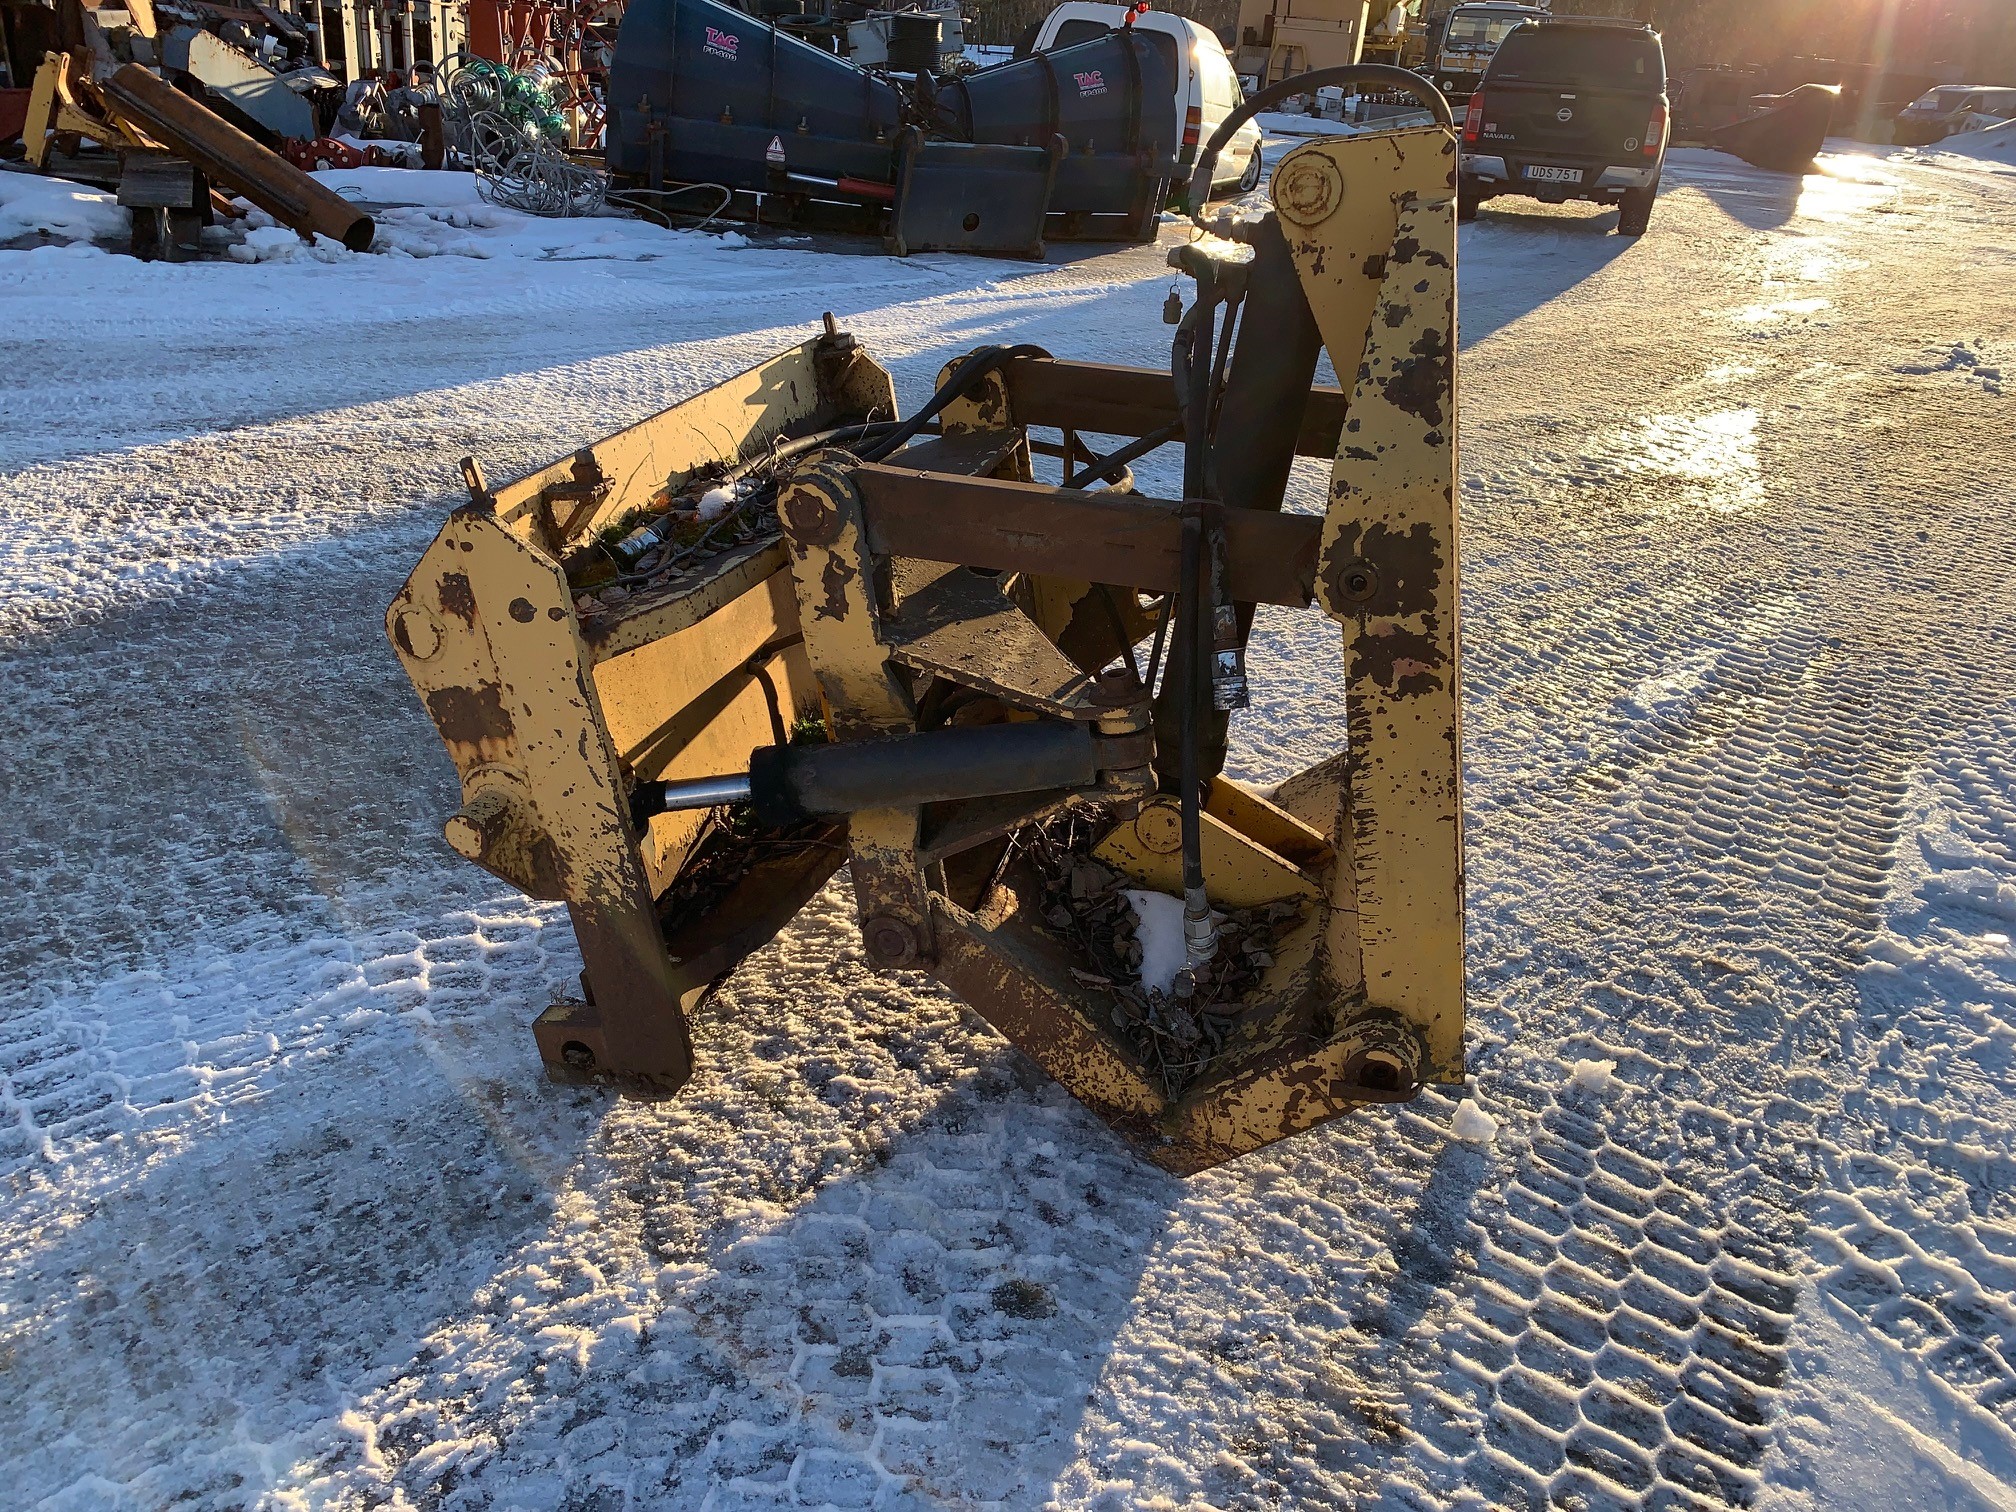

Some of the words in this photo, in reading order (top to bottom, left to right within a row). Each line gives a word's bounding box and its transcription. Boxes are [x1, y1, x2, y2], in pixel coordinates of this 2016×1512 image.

[705, 26, 739, 51] TAC
[1073, 70, 1104, 87] TAC
[1483, 132, 1515, 140] NAVARA
[1531, 166, 1554, 178] UDS
[1556, 168, 1578, 181] 751
